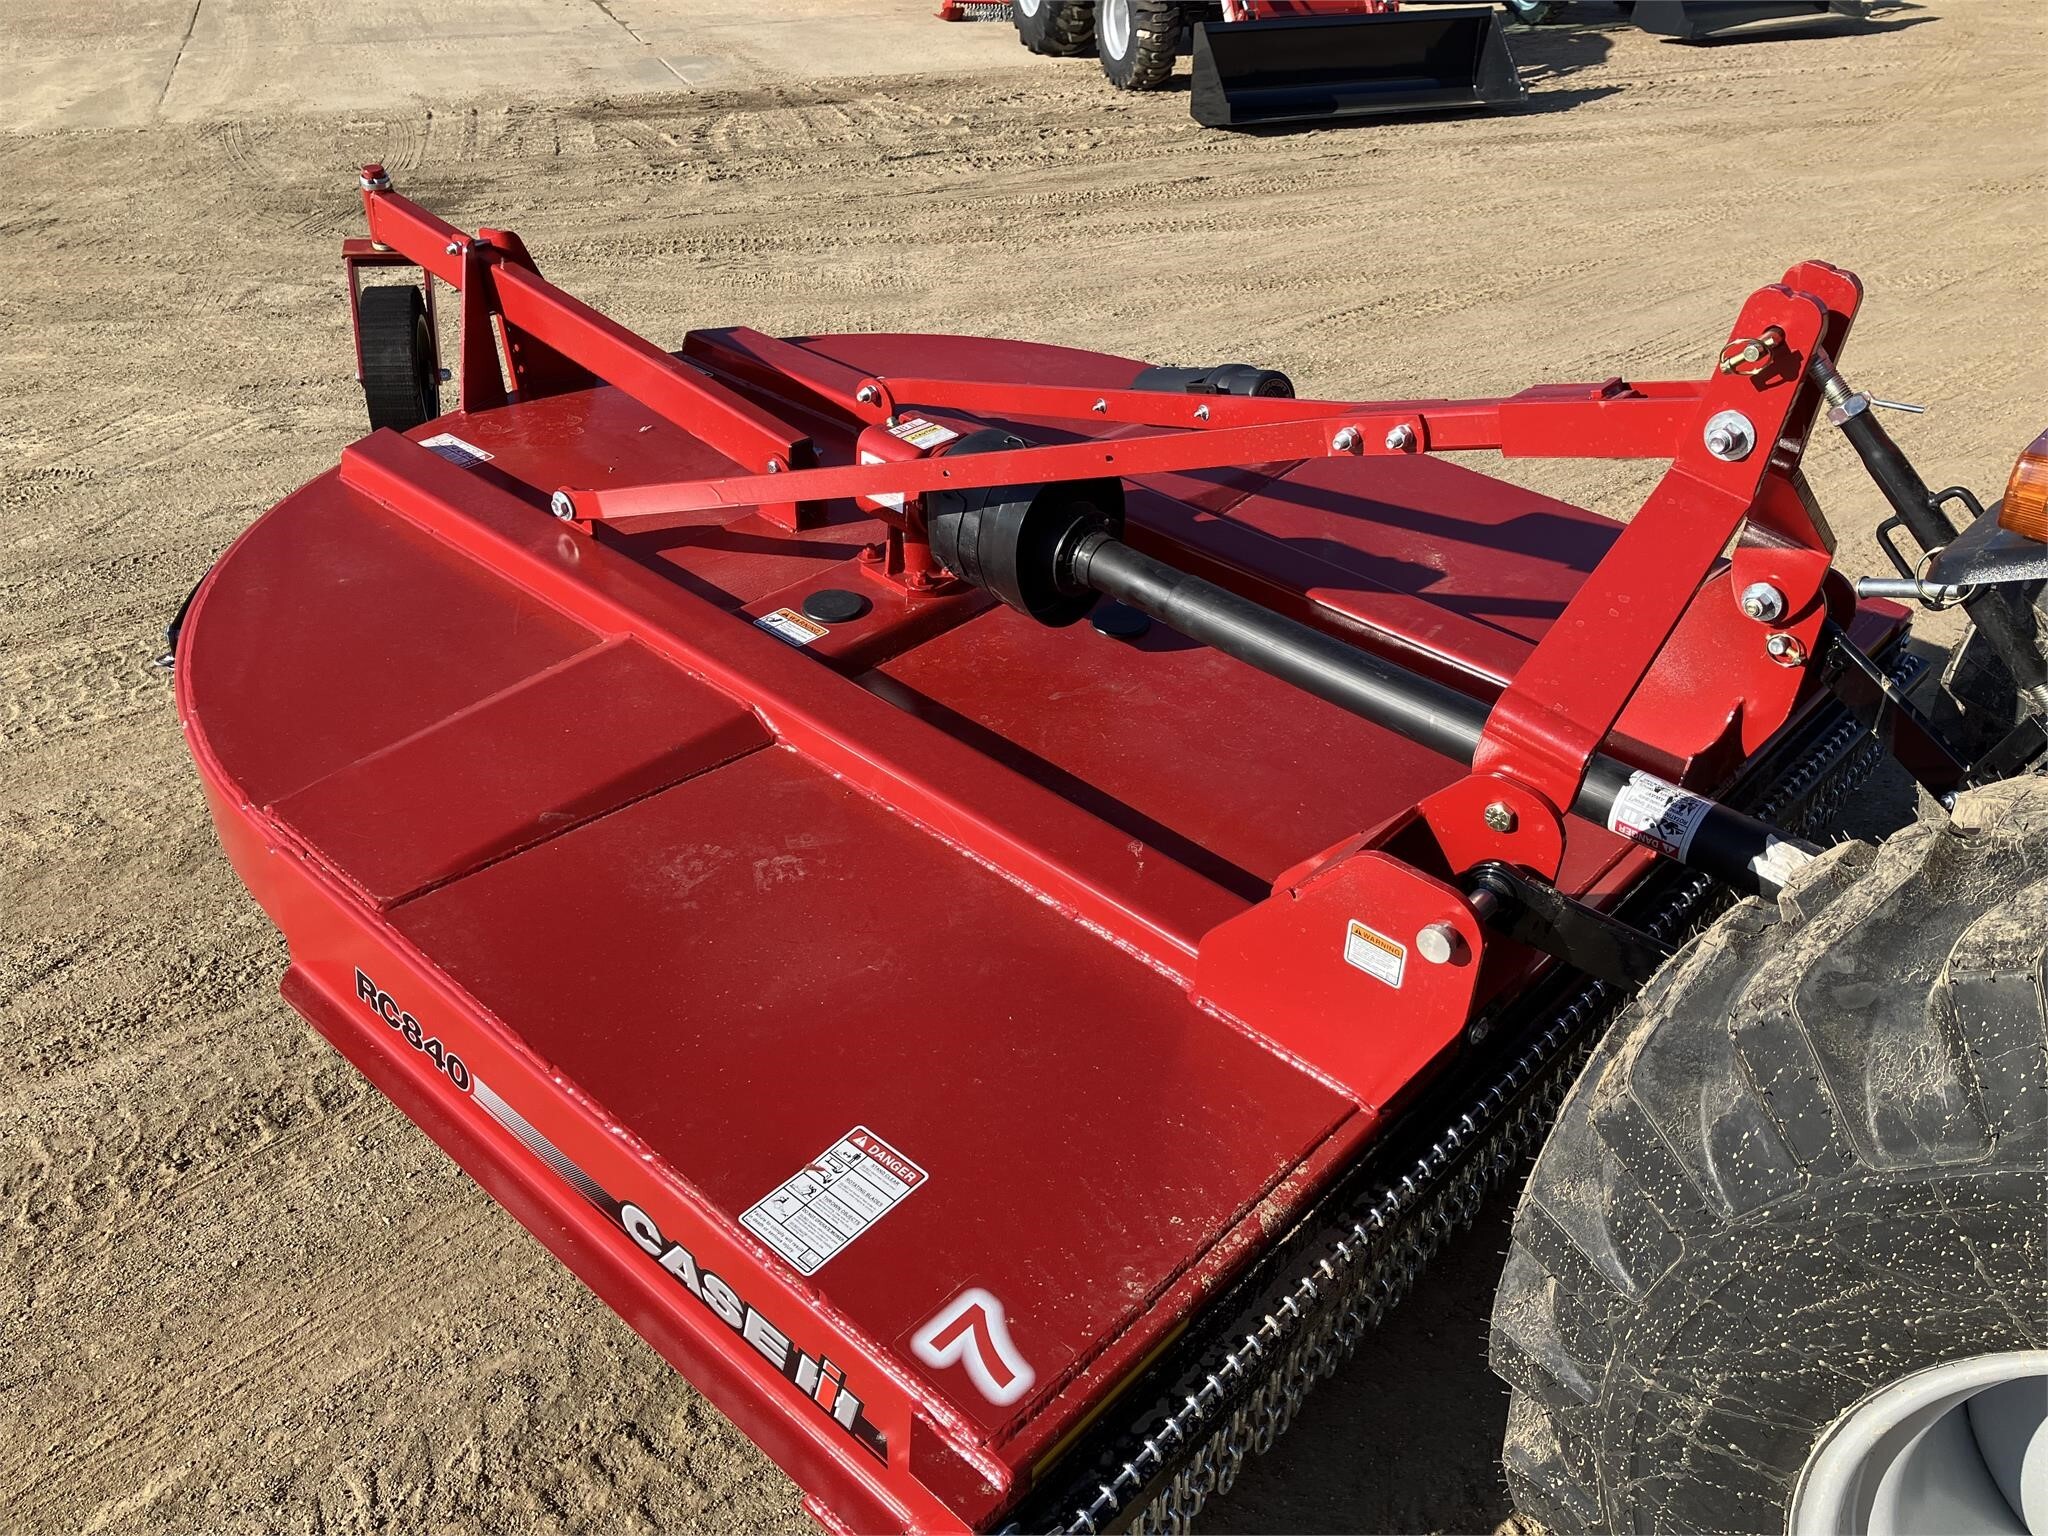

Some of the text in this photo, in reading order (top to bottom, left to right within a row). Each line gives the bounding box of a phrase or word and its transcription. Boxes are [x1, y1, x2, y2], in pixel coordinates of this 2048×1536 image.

[789, 614, 820, 634] WARNING
[1618, 824, 1659, 848] DANGER
[1363, 932, 1401, 956] WARNING
[354, 965, 472, 1092] RC840
[866, 1144, 917, 1182] DANGER
[870, 1163, 886, 1175] STAND
[883, 1173, 901, 1186] CLEAR
[844, 1177, 867, 1194] ROTATING
[864, 1192, 884, 1207] BLADES
[821, 1195, 841, 1211] THROWN
[839, 1209, 861, 1226] OBJECTS
[752, 1217, 764, 1227] death
[767, 1229, 783, 1243] serious
[752, 1210, 767, 1222] Failure
[769, 1224, 785, 1237] comply
[791, 1241, 804, 1252] result
[813, 1217, 832, 1232] OPERATE
[829, 1229, 845, 1242] MOWER
[621, 1204, 791, 1372] CASE
[921, 1297, 1024, 1396] 7
